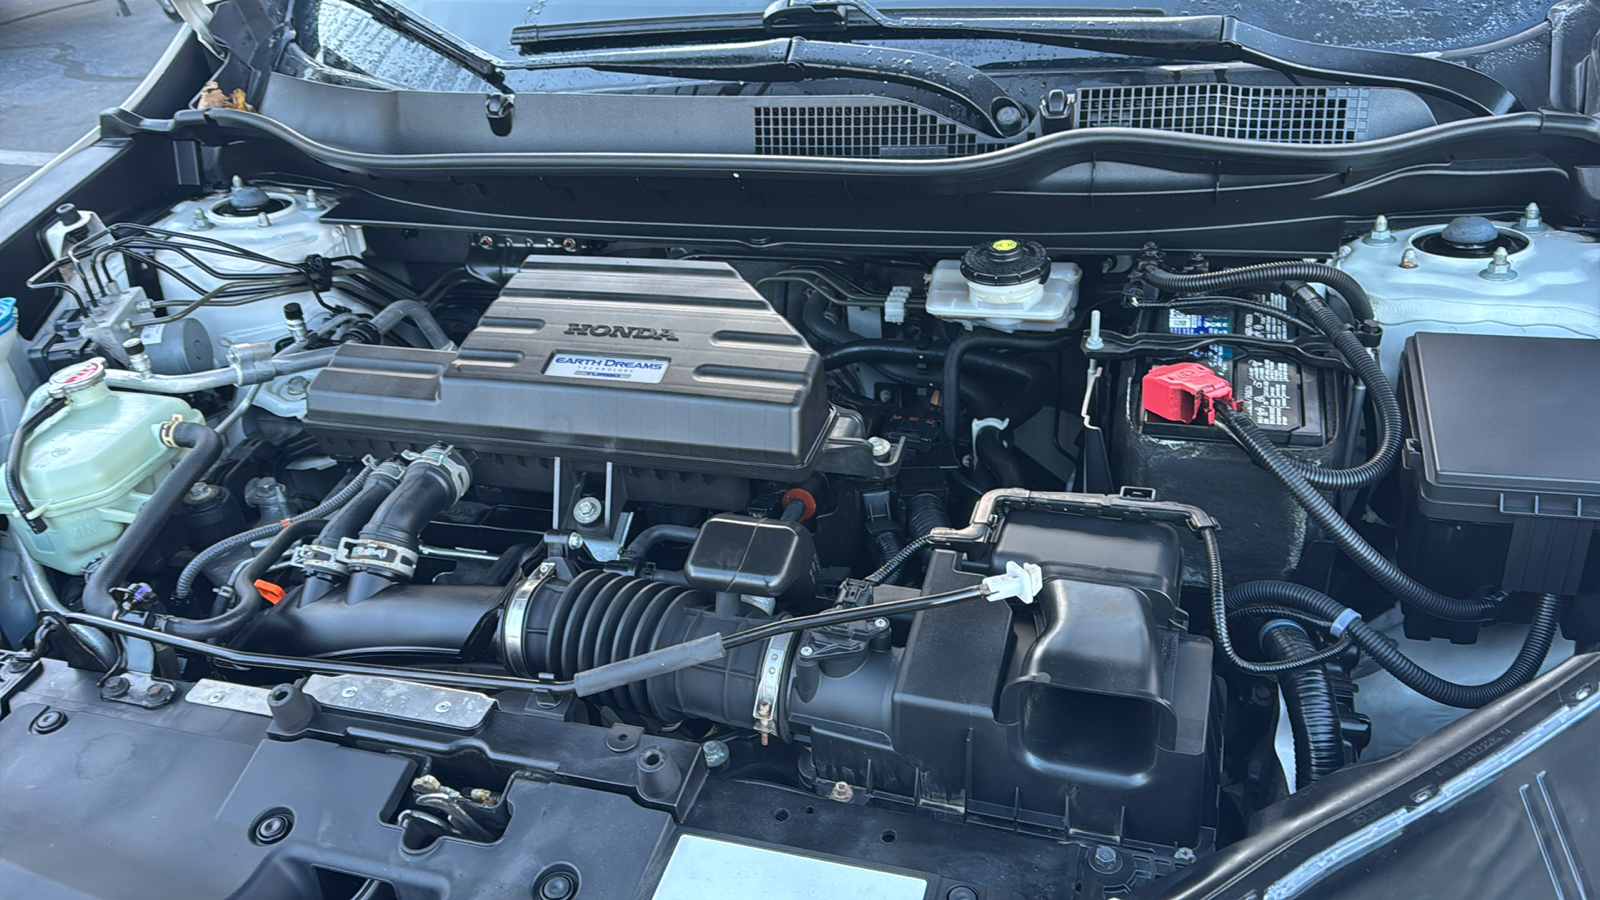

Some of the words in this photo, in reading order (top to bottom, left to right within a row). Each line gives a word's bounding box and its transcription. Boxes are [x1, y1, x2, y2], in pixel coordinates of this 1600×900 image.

[564, 323, 679, 341] HONDA
[555, 357, 602, 366] EARTH
[604, 359, 663, 370] DREAMS
